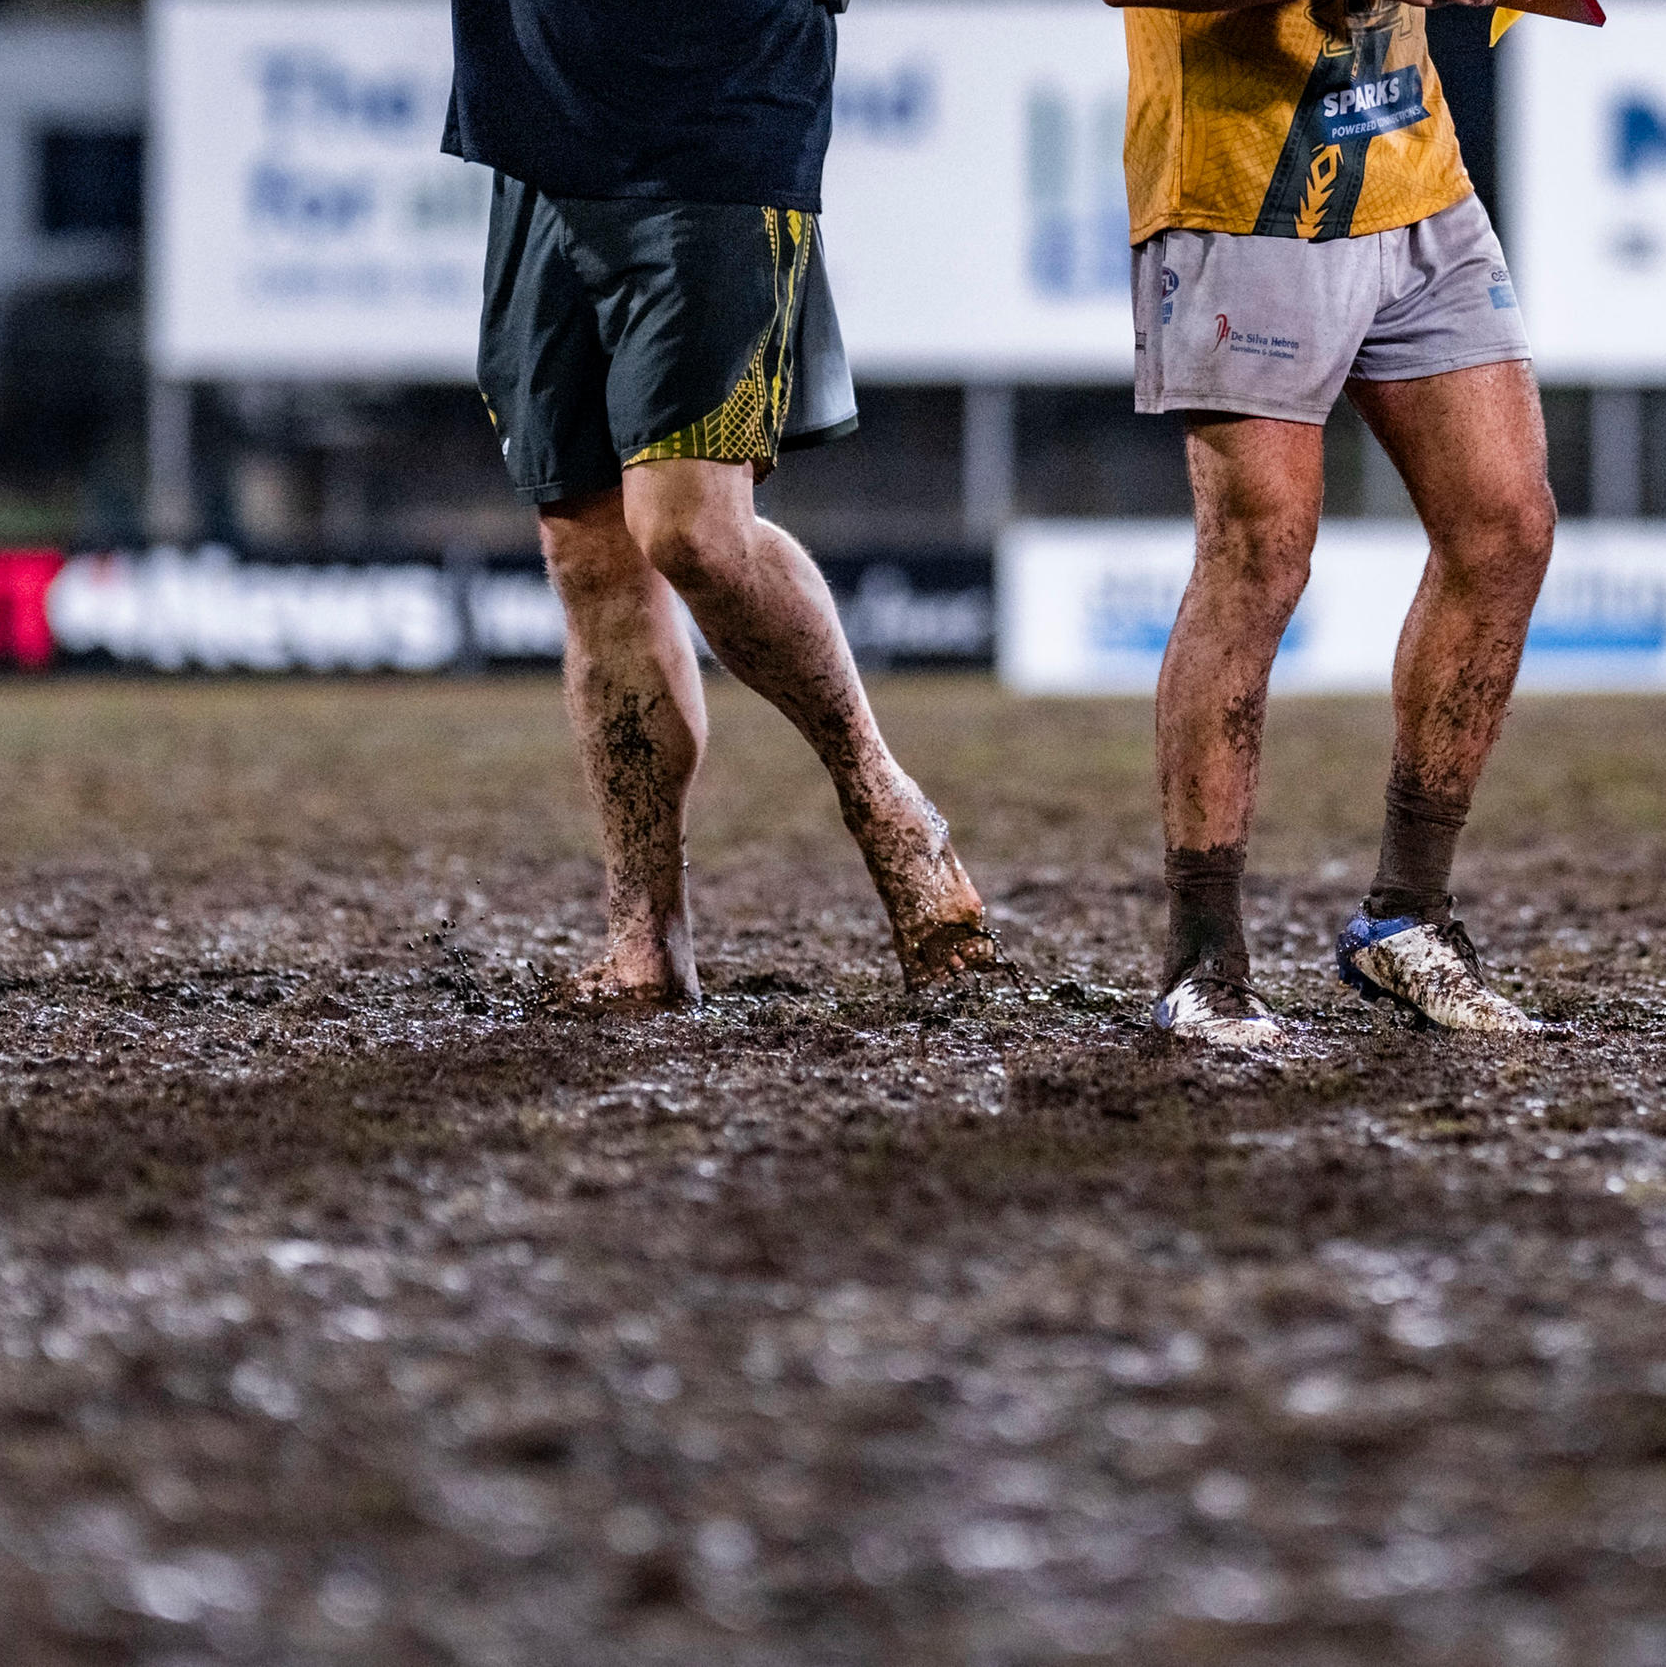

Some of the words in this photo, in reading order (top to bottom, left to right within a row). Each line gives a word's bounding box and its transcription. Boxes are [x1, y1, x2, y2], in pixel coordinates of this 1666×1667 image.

[1323, 77, 1400, 118] SPARKS
[1332, 120, 1377, 138] POWERED
[1231, 331, 1244, 342] De
[1246, 334, 1268, 345] Silva
[1271, 337, 1299, 349] Hebron
